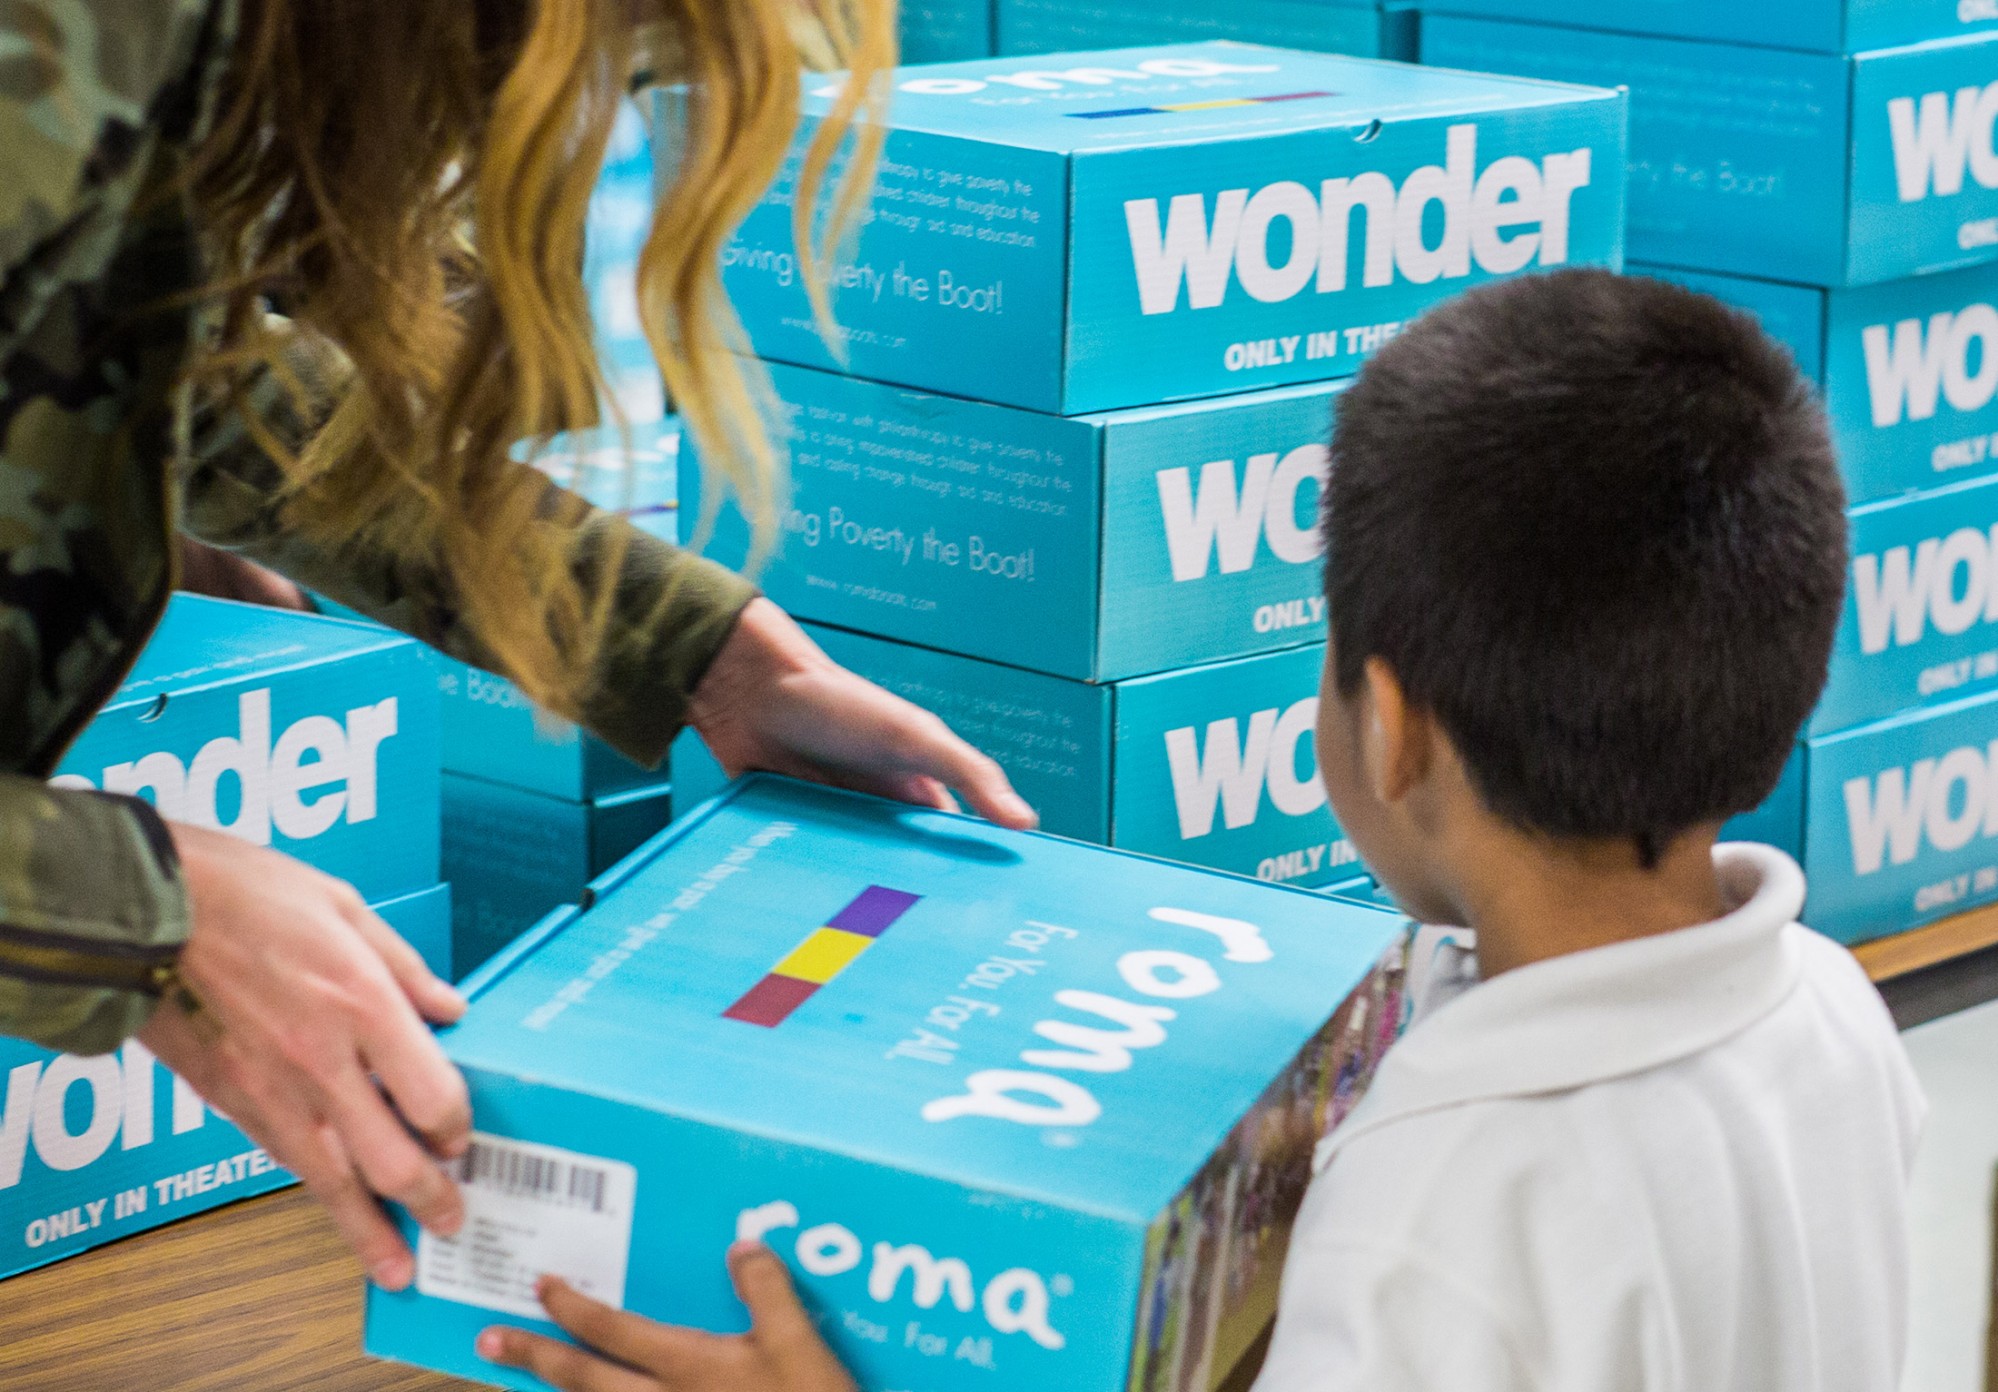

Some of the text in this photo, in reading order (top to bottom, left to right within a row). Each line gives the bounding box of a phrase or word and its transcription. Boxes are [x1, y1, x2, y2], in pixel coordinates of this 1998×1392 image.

[1124, 124, 1592, 315] wonder
[893, 259, 930, 301] the
[938, 269, 1003, 315] Boot!
[1224, 320, 1408, 372] ONLY IN THE
[828, 506, 914, 566] Poverty
[922, 526, 960, 567] the
[968, 535, 1035, 583] Boot!
[1253, 596, 1327, 634] ONLY
[48, 687, 399, 848] nder
[1256, 844, 1328, 882] ONLY
[1003, 919, 1080, 953] For
[921, 906, 1274, 1127] roma
[924, 995, 1002, 1032] For
[25, 1148, 282, 1249] ONLY IN THEATE
[736, 1199, 1067, 1351] roma
